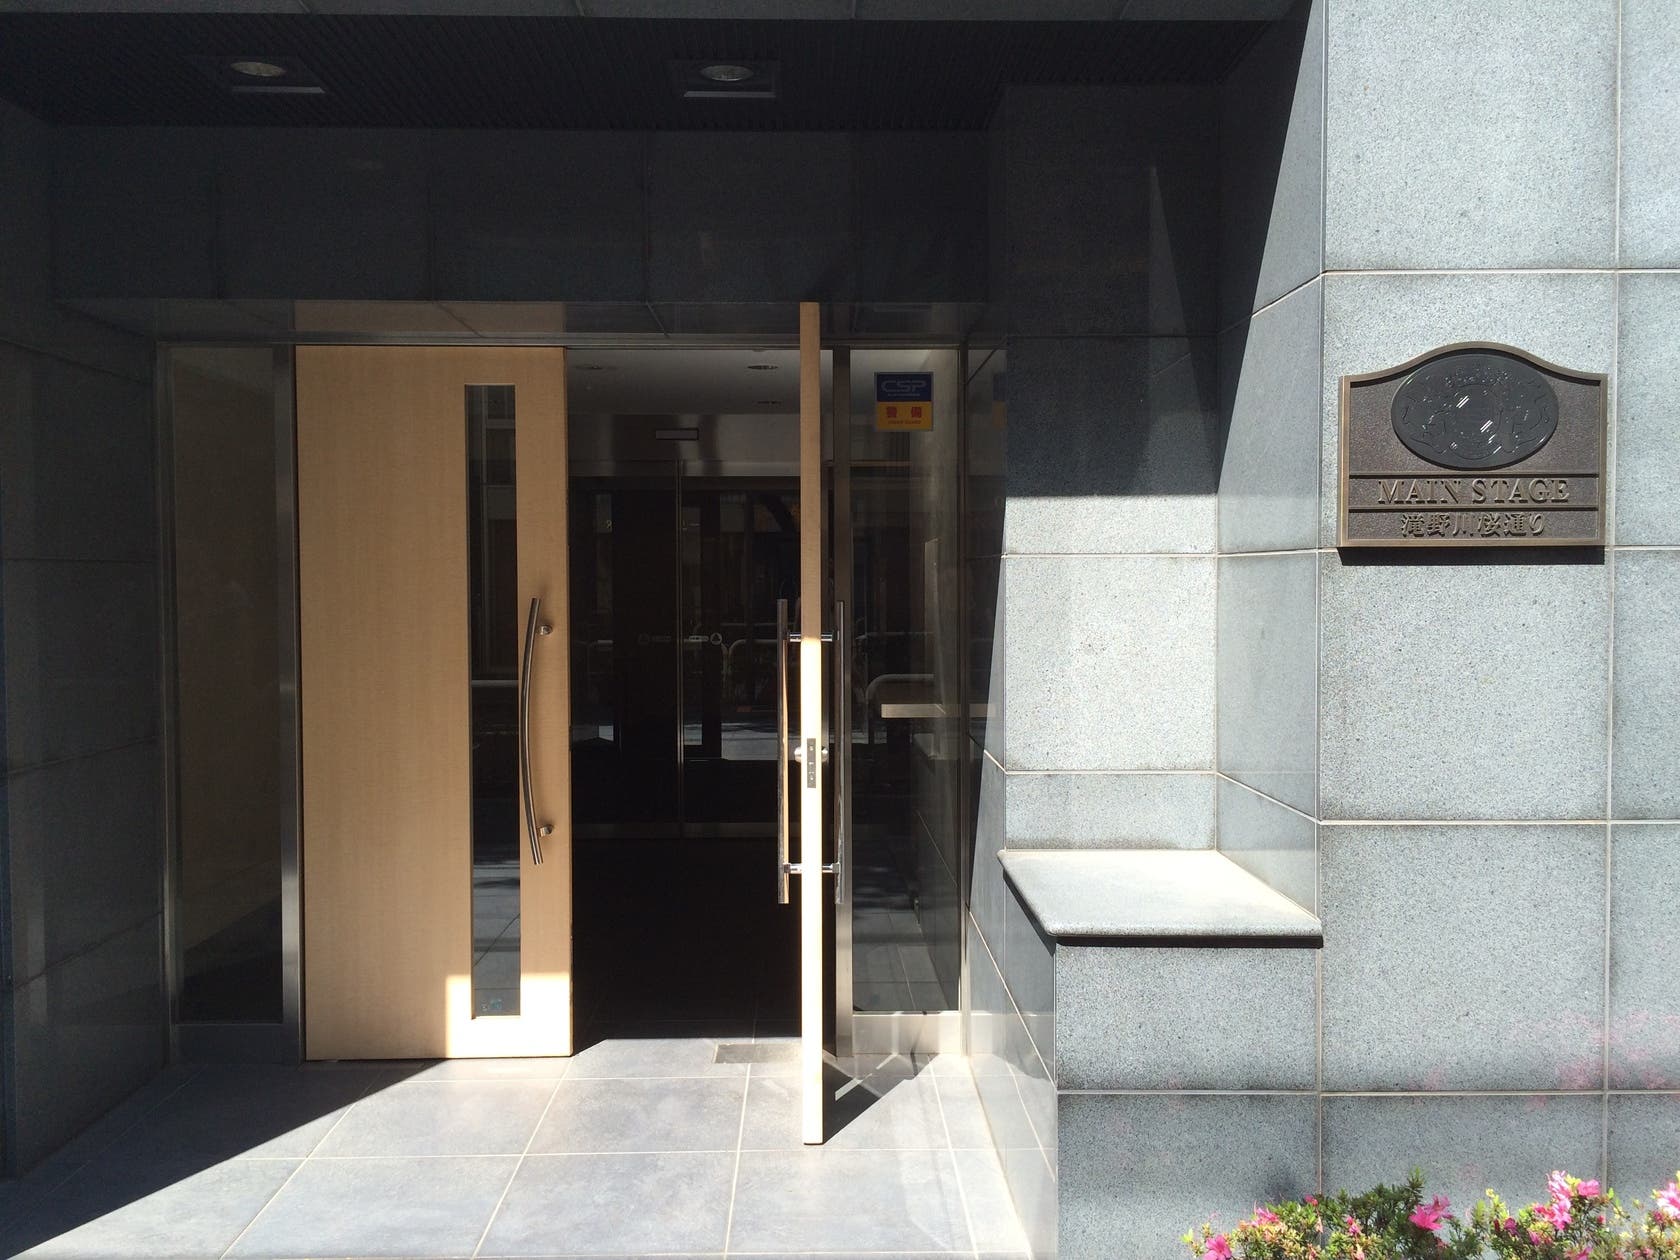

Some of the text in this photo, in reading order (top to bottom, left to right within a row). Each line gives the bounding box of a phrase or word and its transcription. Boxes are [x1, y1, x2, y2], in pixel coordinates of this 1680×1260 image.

[880, 380, 927, 393] CSP
[1377, 478, 1570, 504] MAIN STAGE
[1400, 513, 1545, 537] 滝野川桜通り
